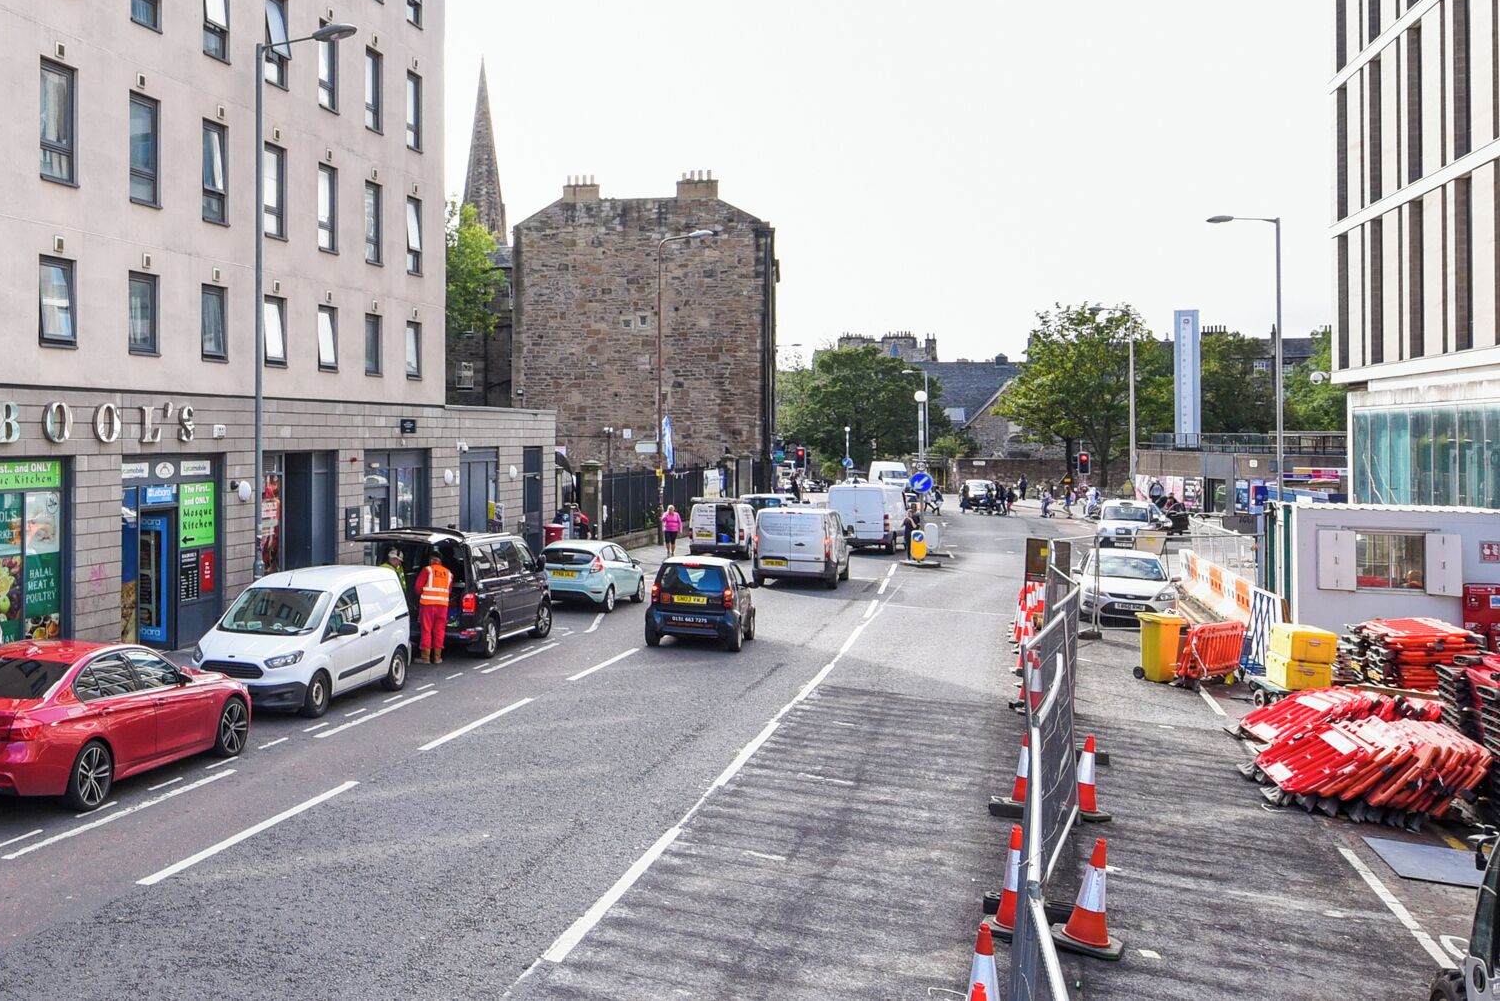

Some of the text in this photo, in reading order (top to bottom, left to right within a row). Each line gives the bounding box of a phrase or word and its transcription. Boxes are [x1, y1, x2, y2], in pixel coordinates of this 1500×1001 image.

[14, 463, 29, 474] and
[30, 462, 51, 473] ONLY
[14, 473, 52, 485] Kitchen
[184, 485, 195, 493] The
[184, 496, 210, 506] and ONLY
[183, 508, 212, 518] Mosque
[182, 518, 213, 531] Kitchen
[29, 567, 54, 579] HALAL
[27, 579, 48, 591] MEAT
[25, 588, 57, 605] POULTRY
